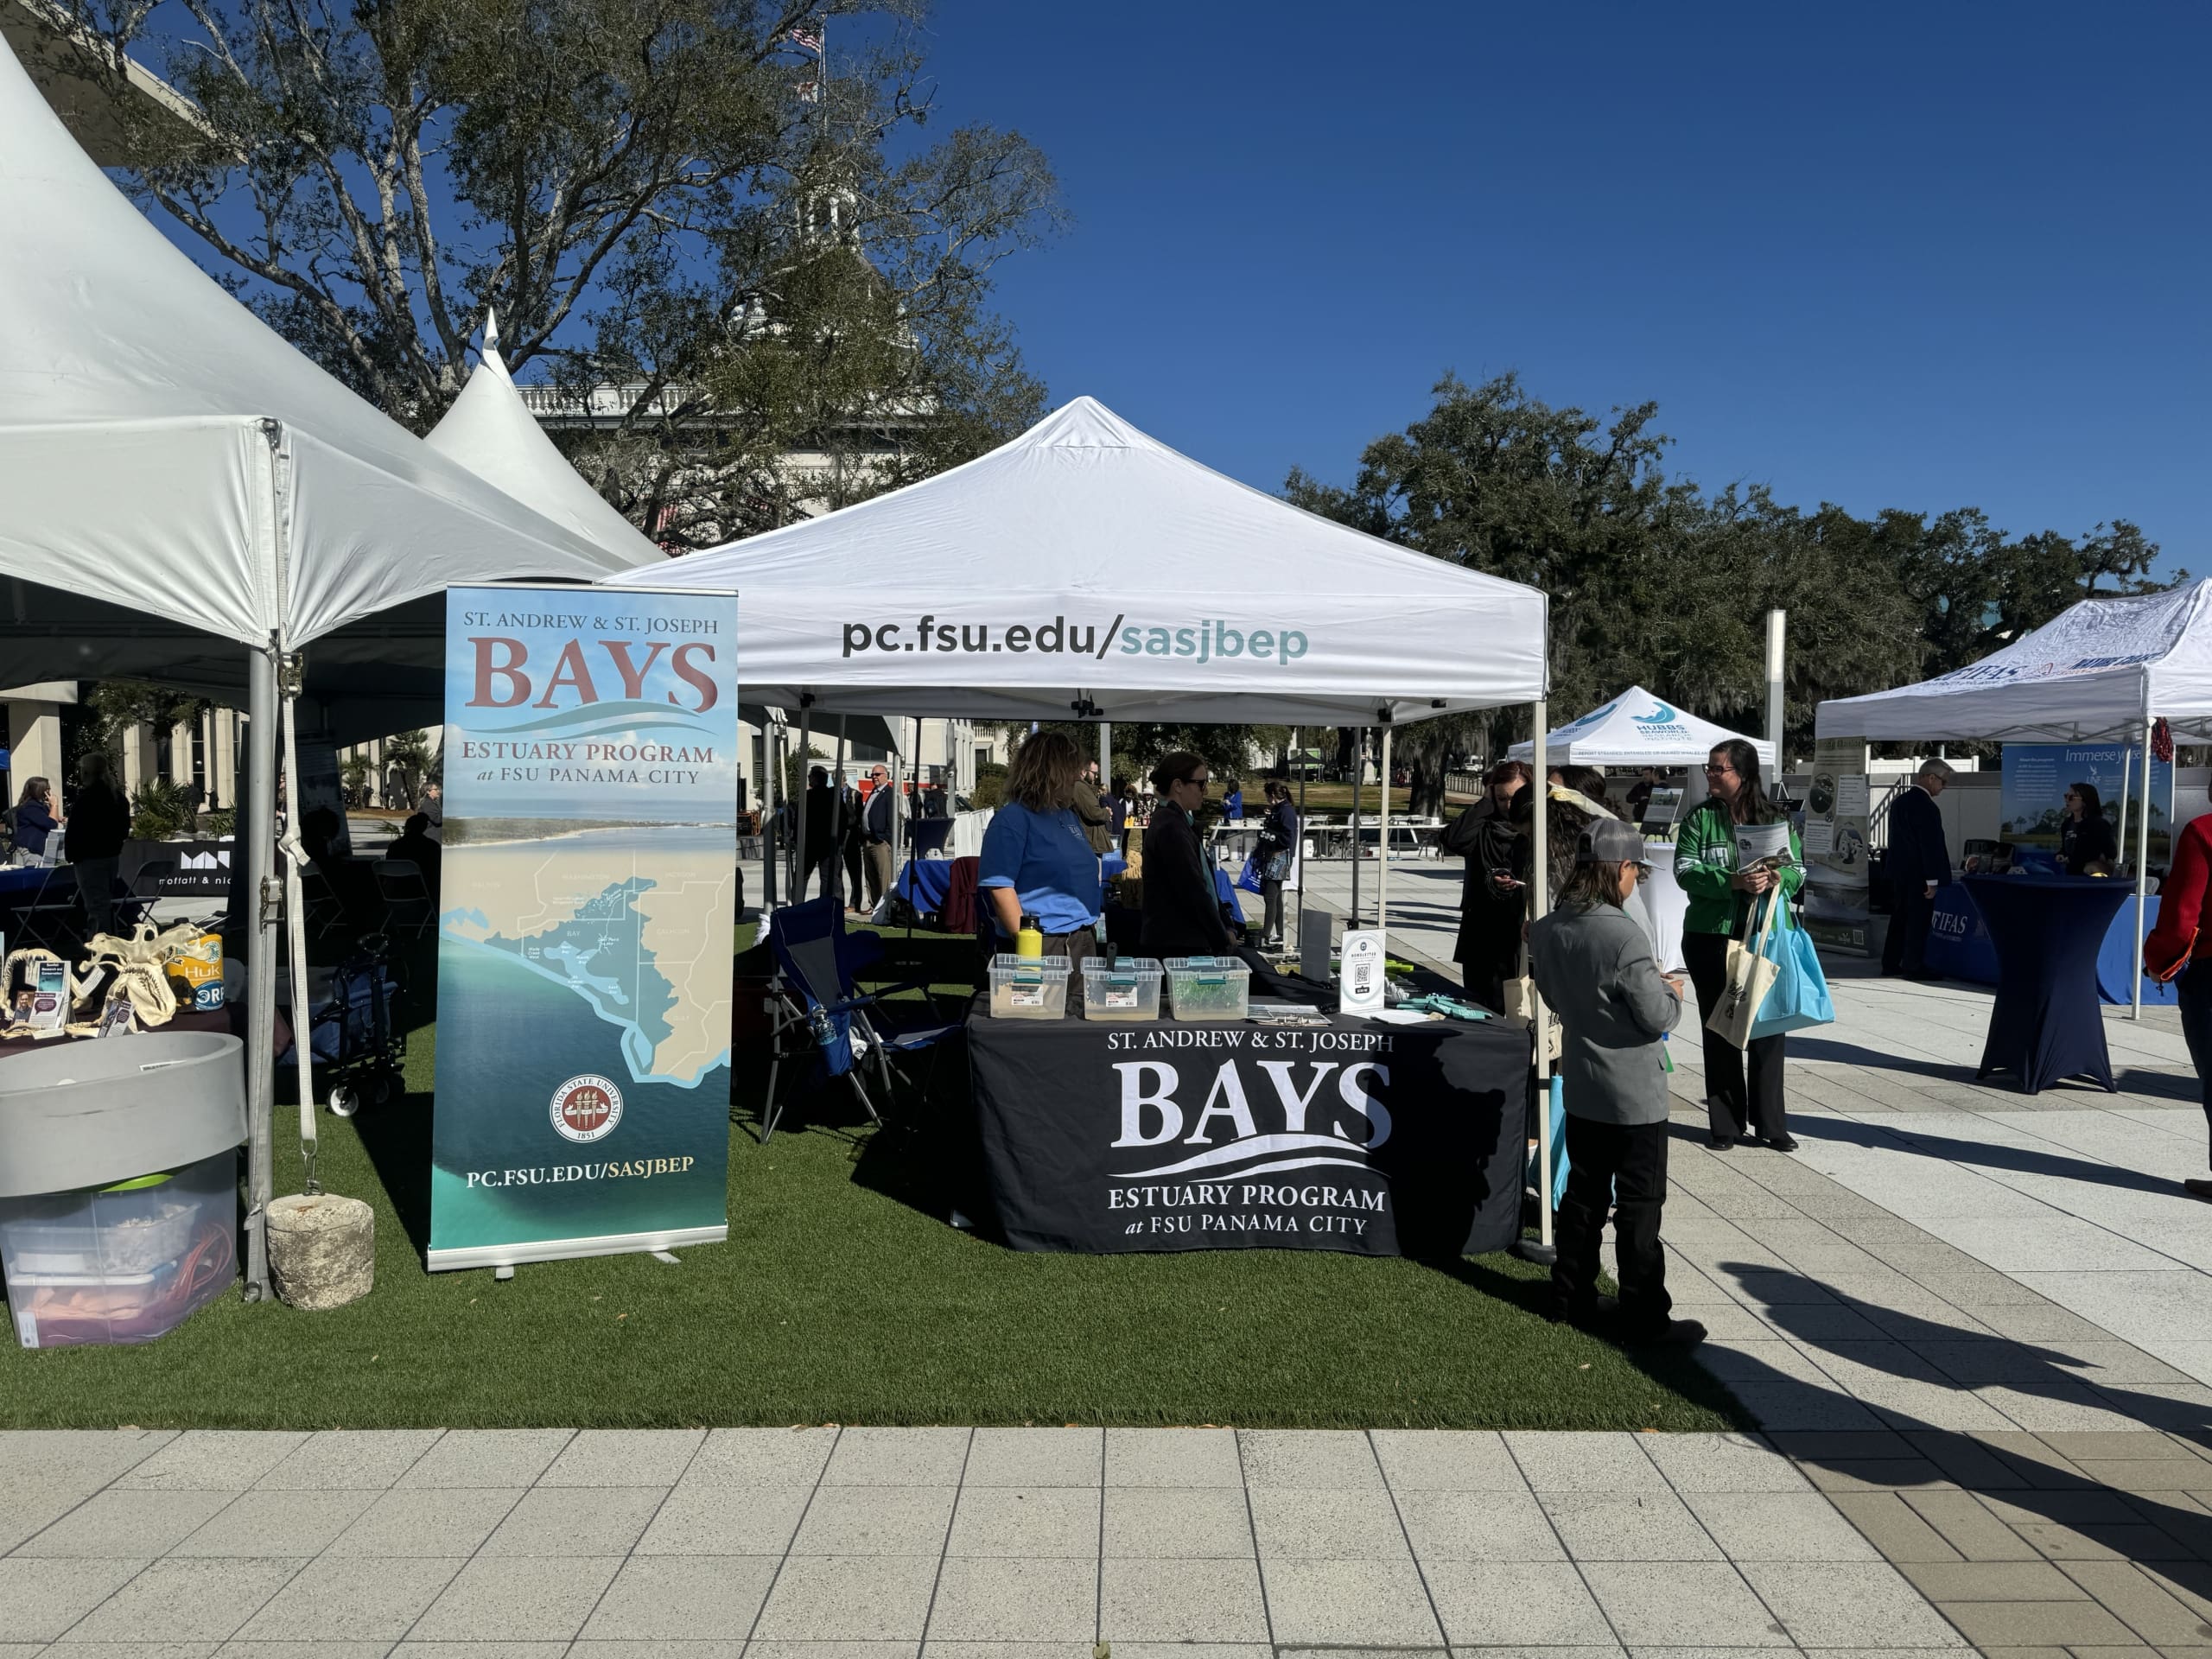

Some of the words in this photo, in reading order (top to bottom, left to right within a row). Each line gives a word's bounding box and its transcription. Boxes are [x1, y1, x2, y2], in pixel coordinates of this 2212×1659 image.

[464, 611, 490, 627] ST.
[496, 613, 588, 630] ANDREW
[593, 615, 609, 630] &
[614, 616, 640, 632] ST.
[645, 617, 719, 635] JOSEPH
[842, 613, 1309, 665] pc.fsu.edu/sasjbep
[465, 637, 719, 714] BAYS
[461, 741, 578, 760] ESTUARY
[586, 744, 715, 764] PROGRAM
[2065, 749, 2116, 762] Immerse
[477, 769, 493, 781] at
[501, 767, 540, 781] FSU
[550, 768, 639, 784] PANAMA
[648, 769, 699, 785] CITY
[201, 876, 209, 885] &
[1939, 912, 1967, 934] IFAS
[185, 964, 220, 978] Huk
[1107, 1032, 1138, 1051] ST.
[1142, 1030, 1246, 1049] ANDREW
[1251, 1031, 1270, 1049] &
[1274, 1032, 1305, 1050] ST.
[1309, 1033, 1395, 1053] JOSEPH
[554, 1090, 568, 1128] FLORIDA
[568, 1077, 594, 1090] STATE
[597, 1079, 620, 1126] UNIVERSITY
[1110, 1058, 1393, 1150] BAYS
[577, 1131, 595, 1140] 1851
[466, 1155, 694, 1189] PC.FSU.EDU/SASJBEP
[1107, 1184, 1234, 1210] ESTUARY
[1242, 1185, 1386, 1212] PROGRAM
[1125, 1220, 1143, 1236] at
[1150, 1216, 1192, 1234] FSU
[1201, 1214, 1300, 1232] PANAMA
[1309, 1216, 1369, 1236] CITY
